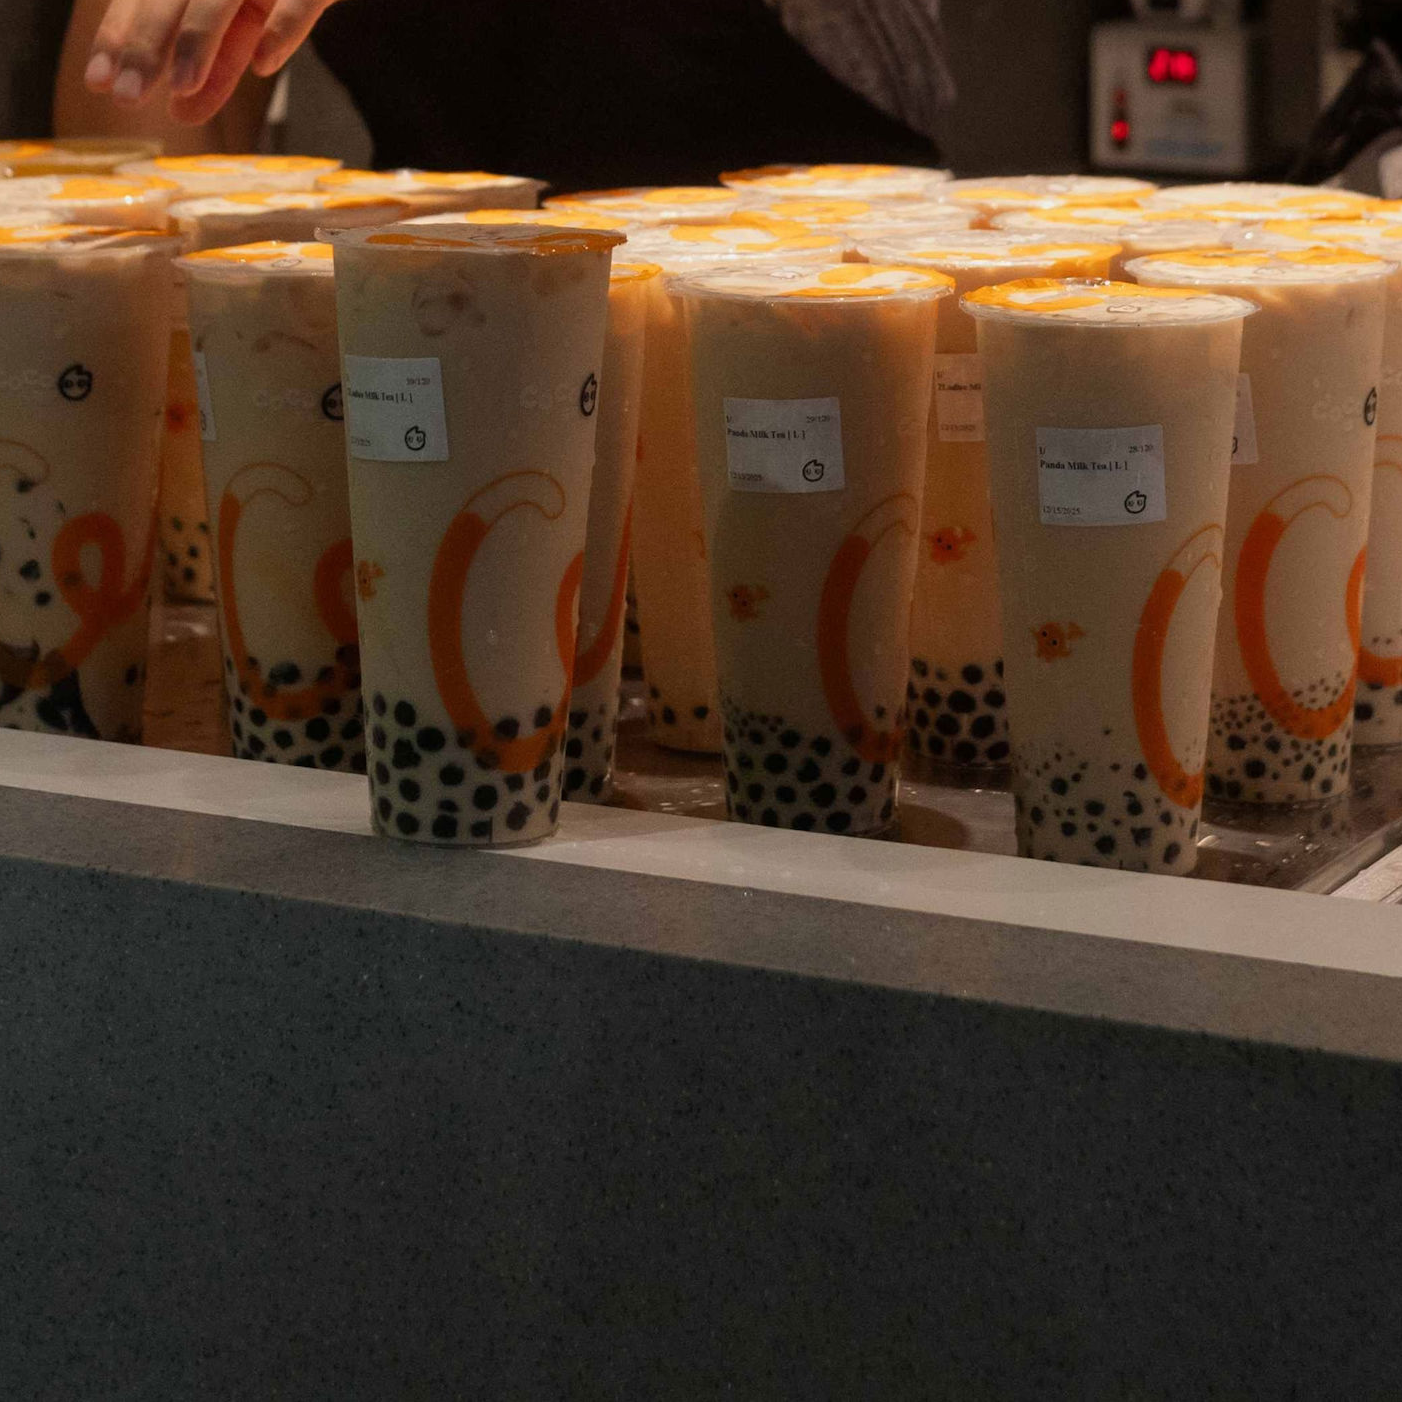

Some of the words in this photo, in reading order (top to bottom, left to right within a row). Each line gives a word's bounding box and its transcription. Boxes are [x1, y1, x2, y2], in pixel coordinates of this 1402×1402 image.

[750, 430, 769, 439] Milk
[771, 430, 786, 439] Tea
[1039, 460, 1065, 470] Panda
[1068, 461, 1088, 470] Milk
[1091, 461, 1107, 470] Tea
